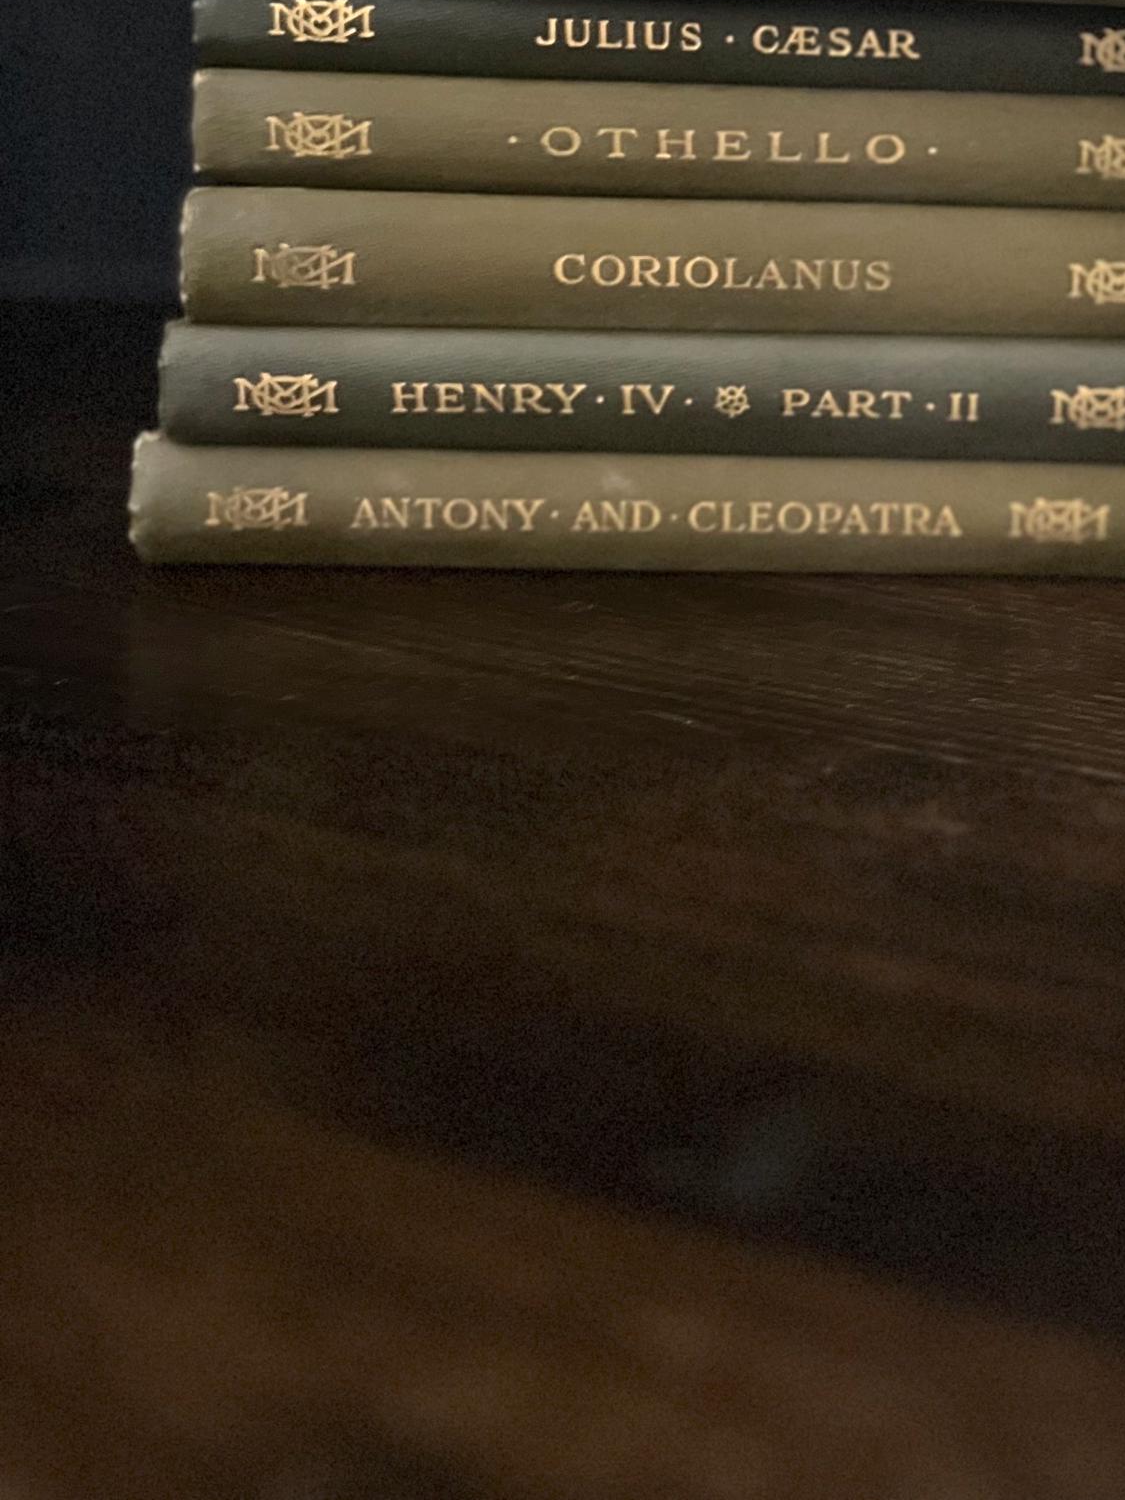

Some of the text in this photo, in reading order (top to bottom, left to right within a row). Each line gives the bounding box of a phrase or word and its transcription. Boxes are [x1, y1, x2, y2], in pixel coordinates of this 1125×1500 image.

[535, 16, 921, 60] JULIUS CÆSAR
[540, 126, 906, 164] OTHELLO
[552, 253, 892, 292] CORIOLANUS
[390, 381, 980, 422] HENRY IV PART II
[349, 496, 963, 538] ANTONY AND CLEOPATRA
